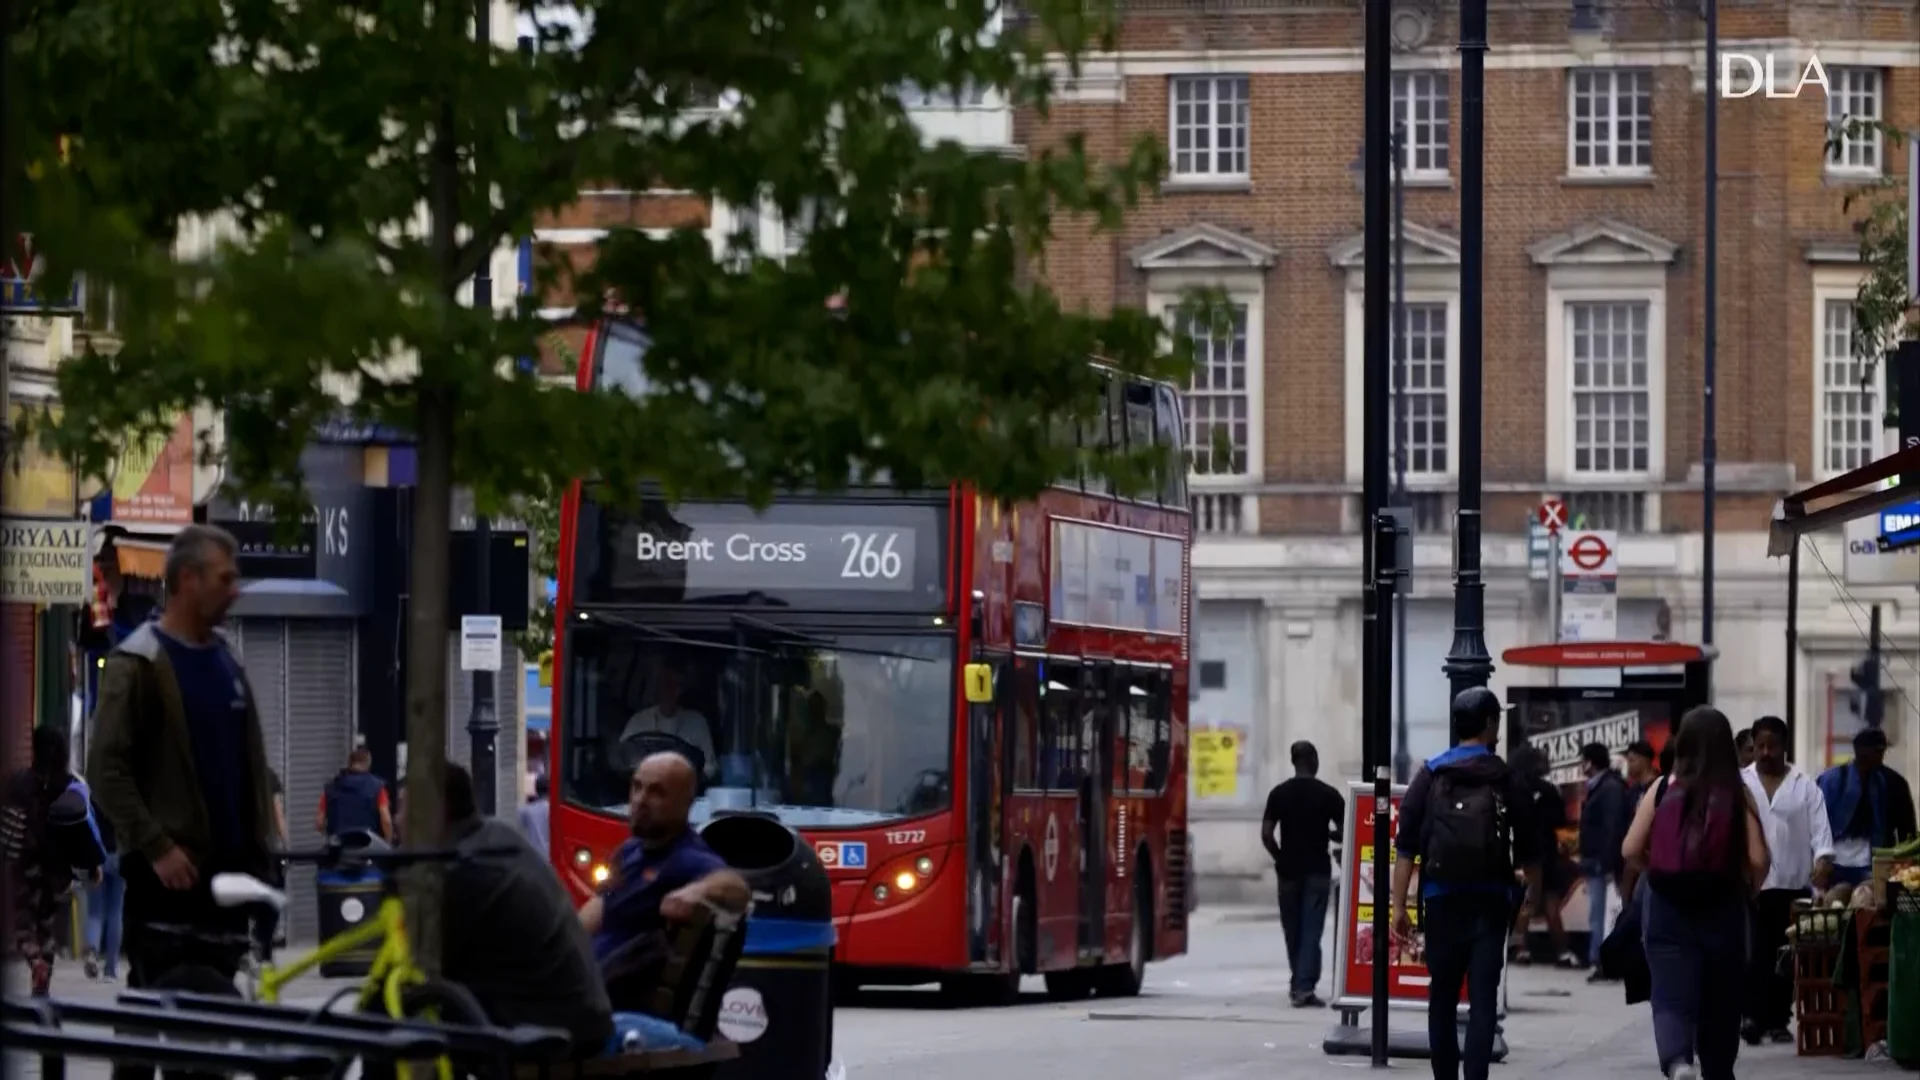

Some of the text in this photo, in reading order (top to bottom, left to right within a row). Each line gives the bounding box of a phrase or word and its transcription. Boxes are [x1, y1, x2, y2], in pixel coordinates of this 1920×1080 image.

[19, 552, 85, 568] EXCHANGE
[636, 531, 902, 579] Brent Cross 266
[21, 581, 84, 597] TRANSFER
